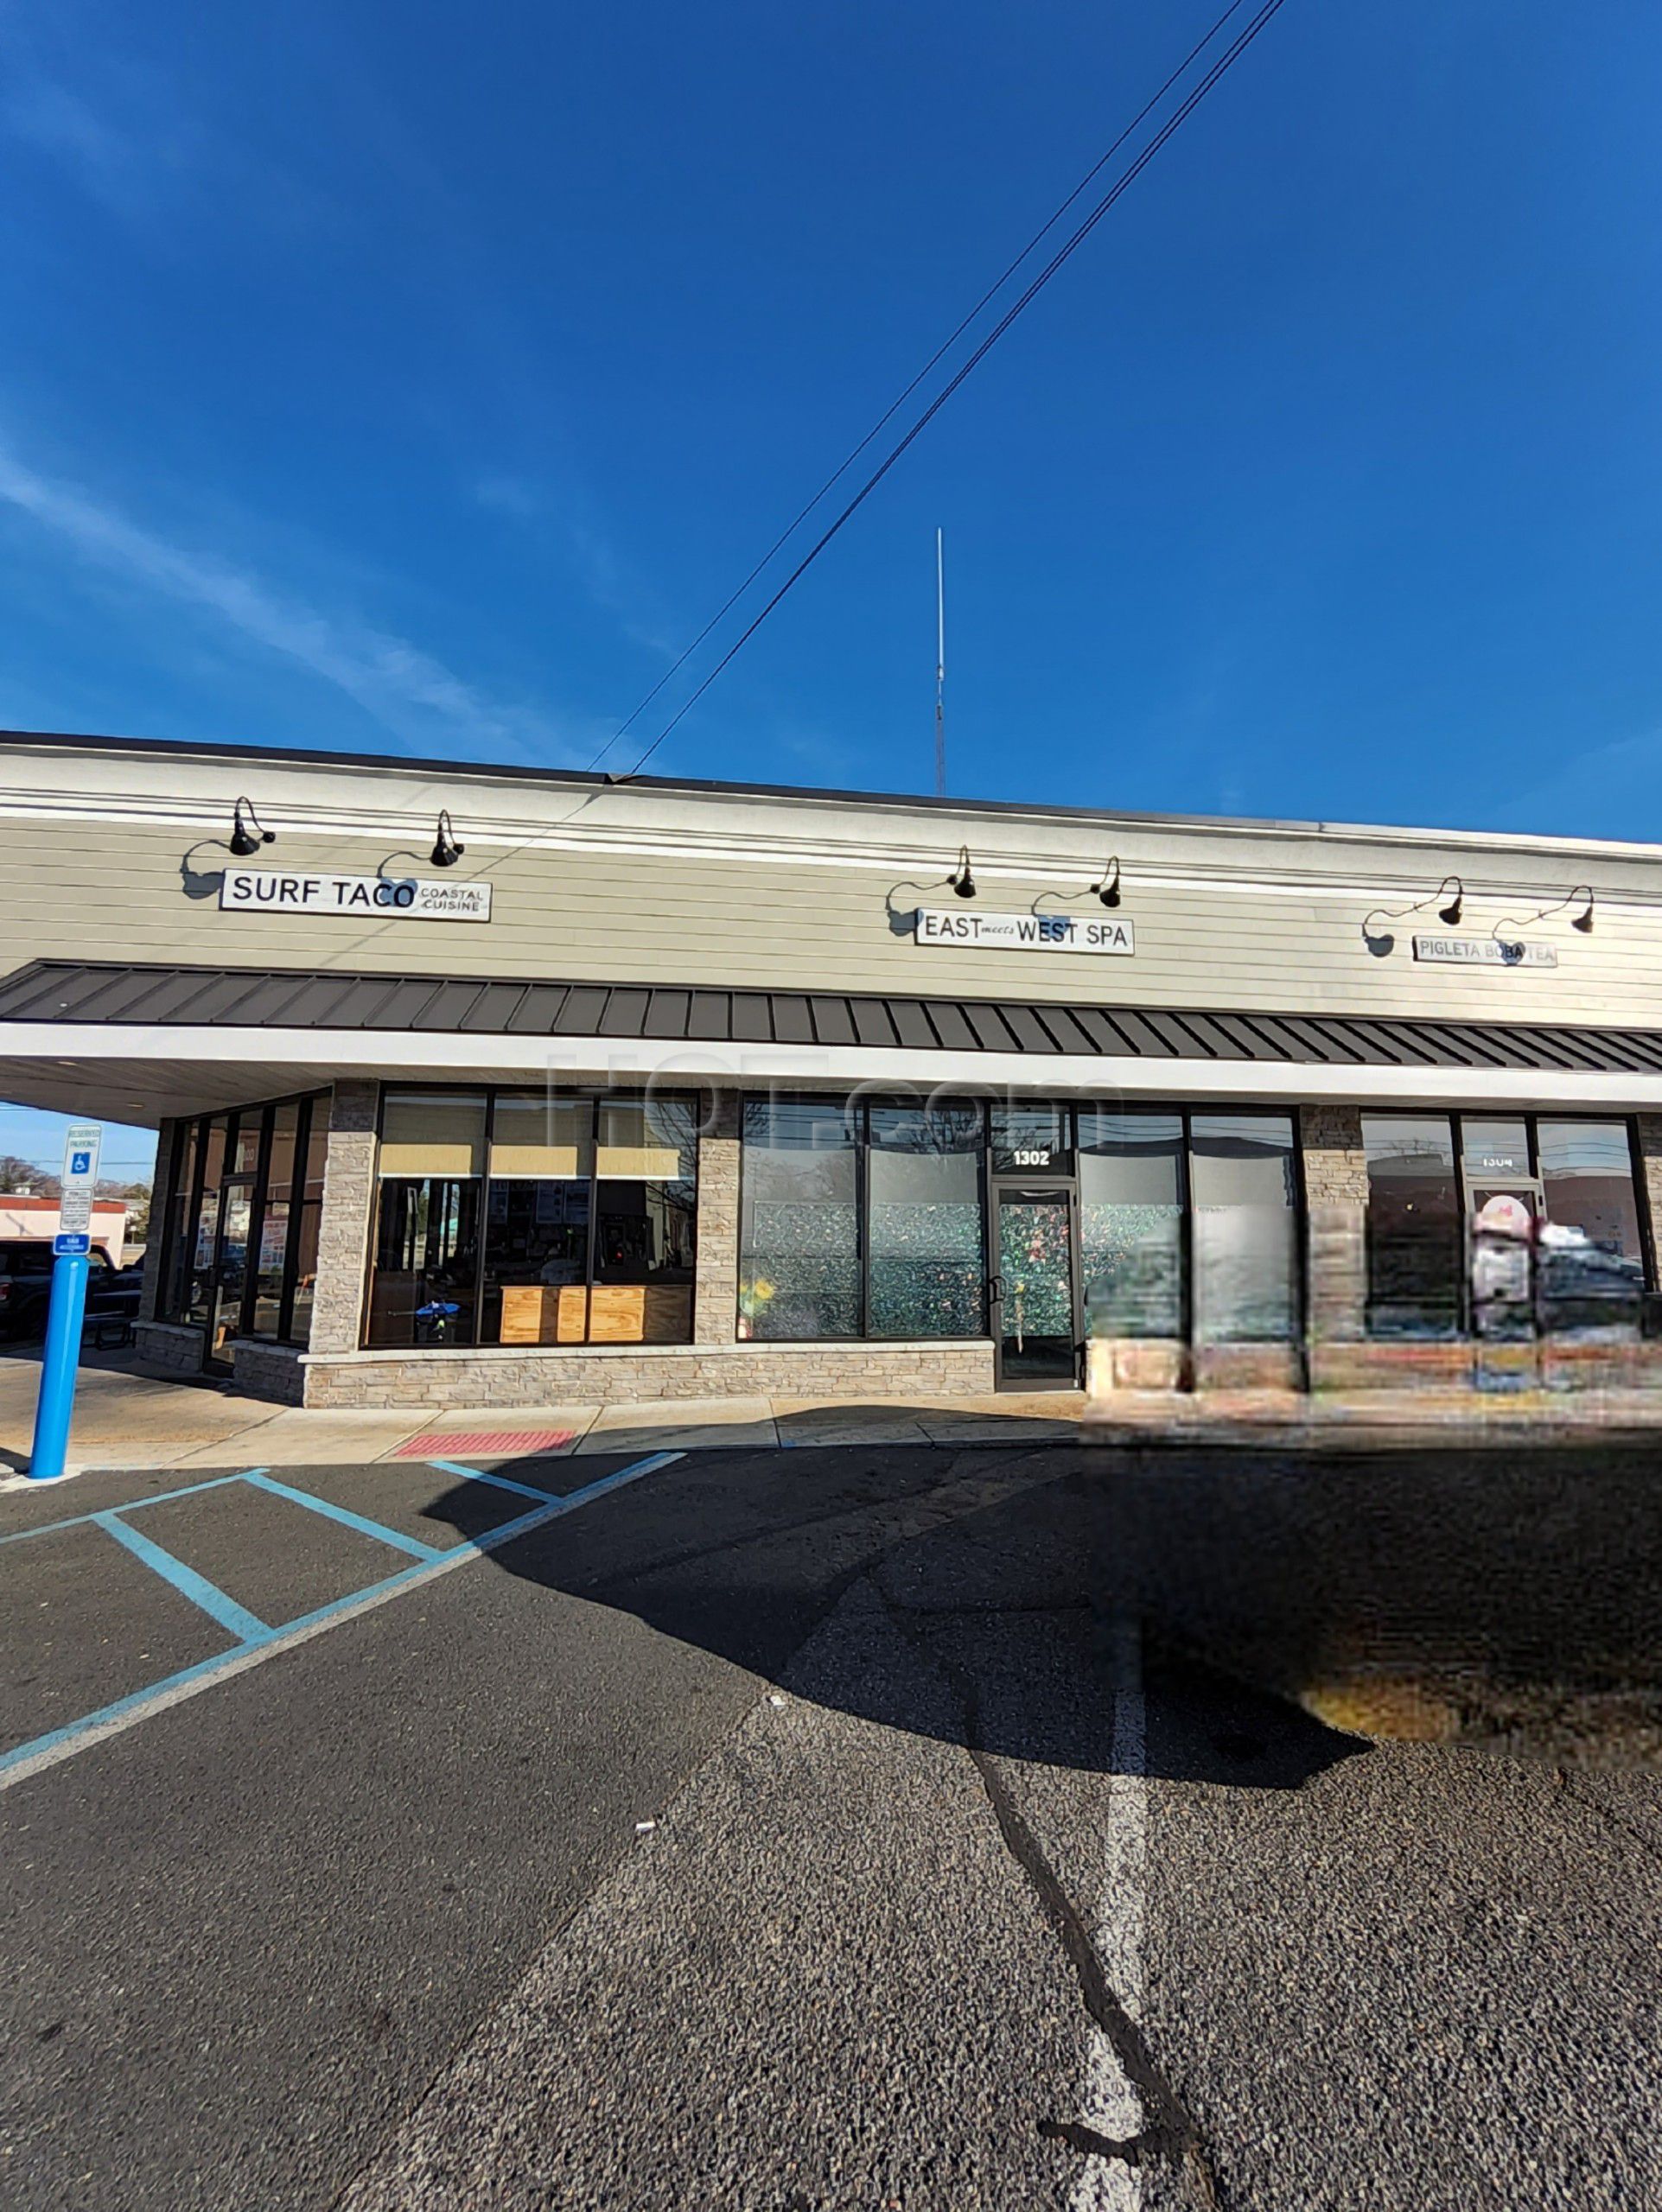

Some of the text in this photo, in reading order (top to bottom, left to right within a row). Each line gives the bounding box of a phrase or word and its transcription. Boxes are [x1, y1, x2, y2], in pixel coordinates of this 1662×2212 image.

[232, 876, 415, 908] SURF TACO
[420, 887, 484, 901] COASTAL
[423, 899, 480, 912] CUISINE
[926, 916, 1128, 946] EAST meets WEST SPA
[1420, 940, 1556, 961] PIGLETA BOBA TEA
[1014, 1150, 1050, 1166] 1302
